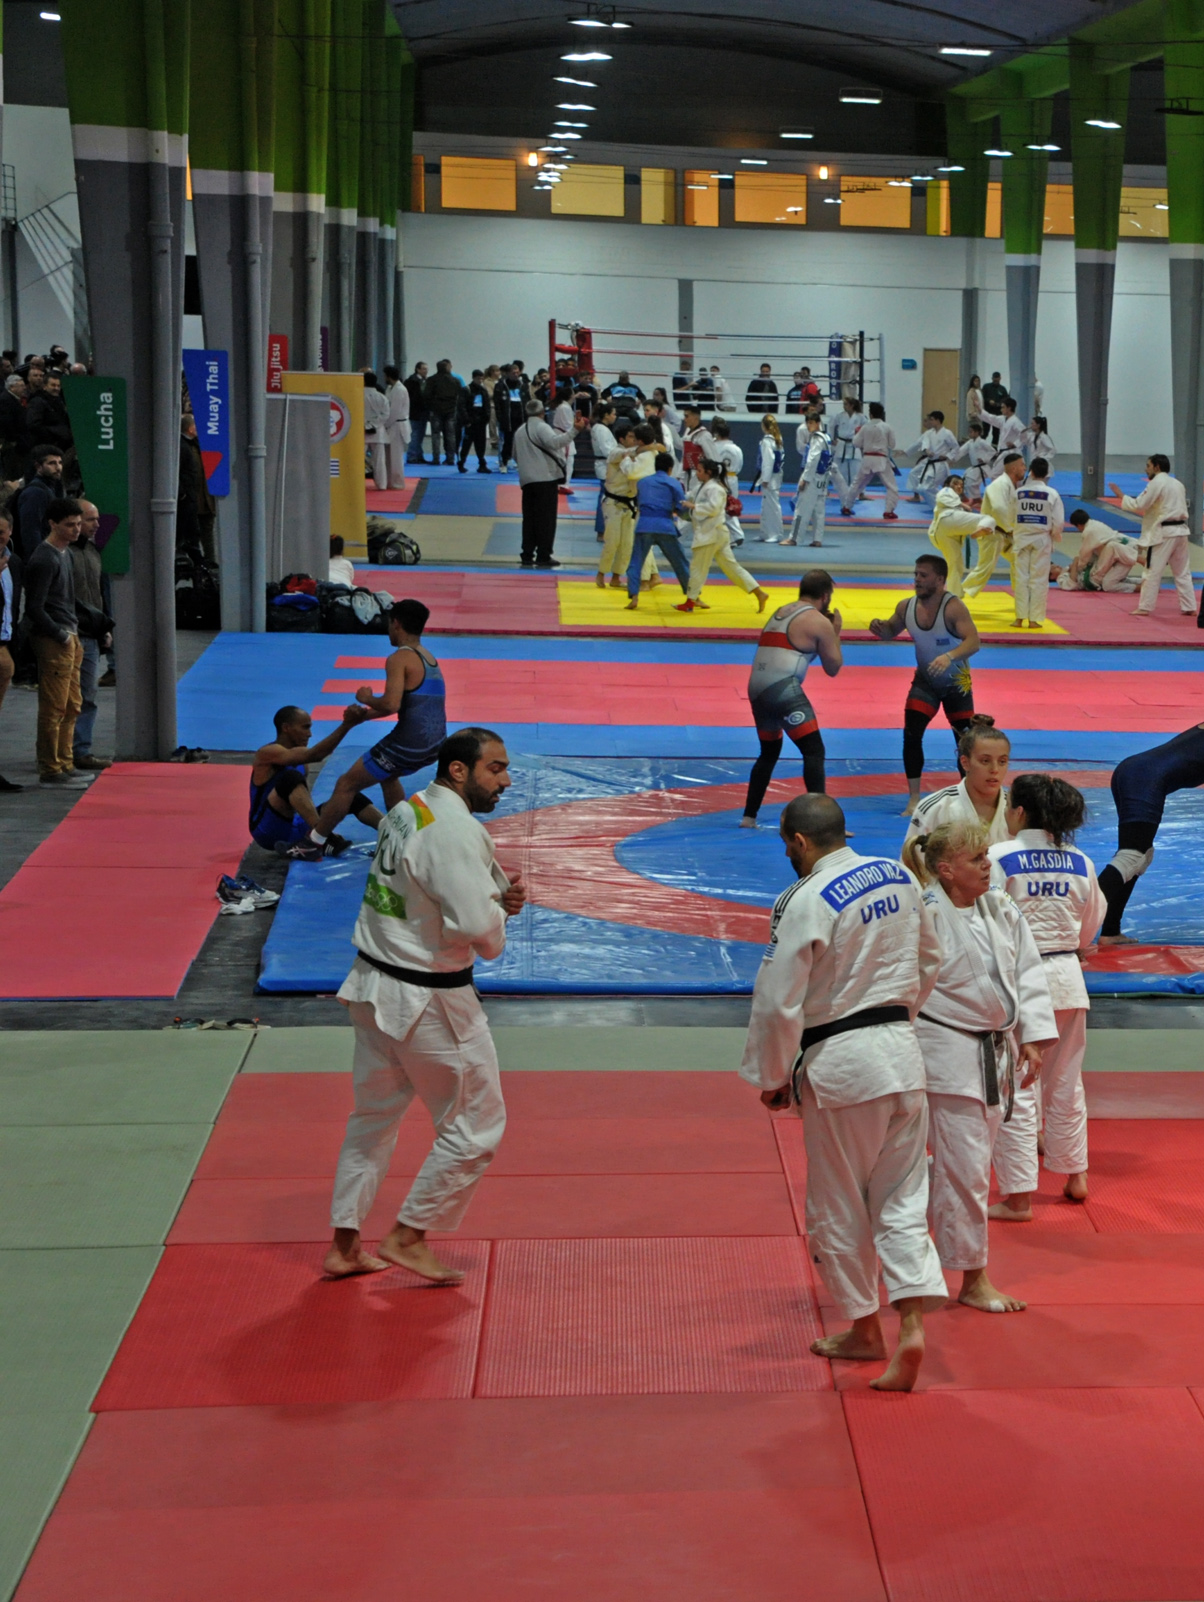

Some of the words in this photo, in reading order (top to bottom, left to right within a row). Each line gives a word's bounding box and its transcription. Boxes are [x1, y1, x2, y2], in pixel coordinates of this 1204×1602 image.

[206, 395, 222, 435] Muay
[1021, 502, 1044, 512] URU
[1018, 851, 1075, 870] M.GASDIA
[829, 865, 884, 904] LEANDRO
[1027, 881, 1070, 897] URU
[860, 894, 900, 925] URU
